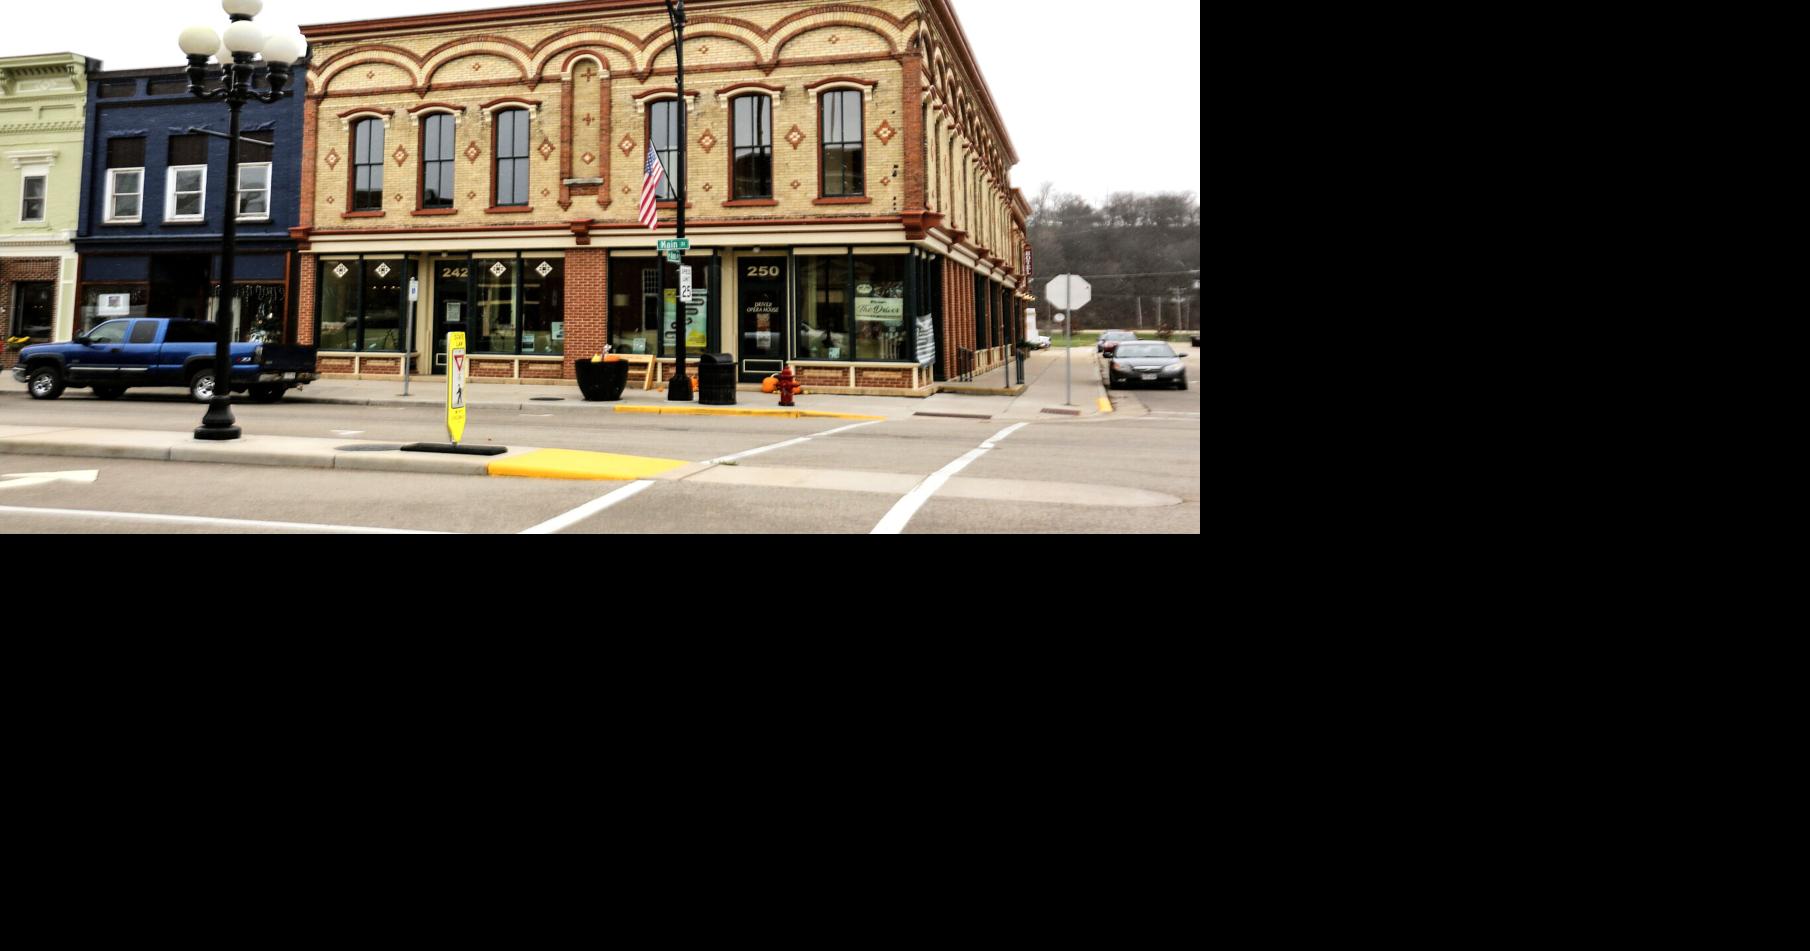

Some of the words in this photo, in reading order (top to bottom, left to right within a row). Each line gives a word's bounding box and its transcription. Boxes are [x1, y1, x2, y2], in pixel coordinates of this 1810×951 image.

[660, 240, 679, 249] Main
[442, 266, 469, 278] 242
[746, 265, 780, 277] 250
[682, 285, 691, 298] 25
